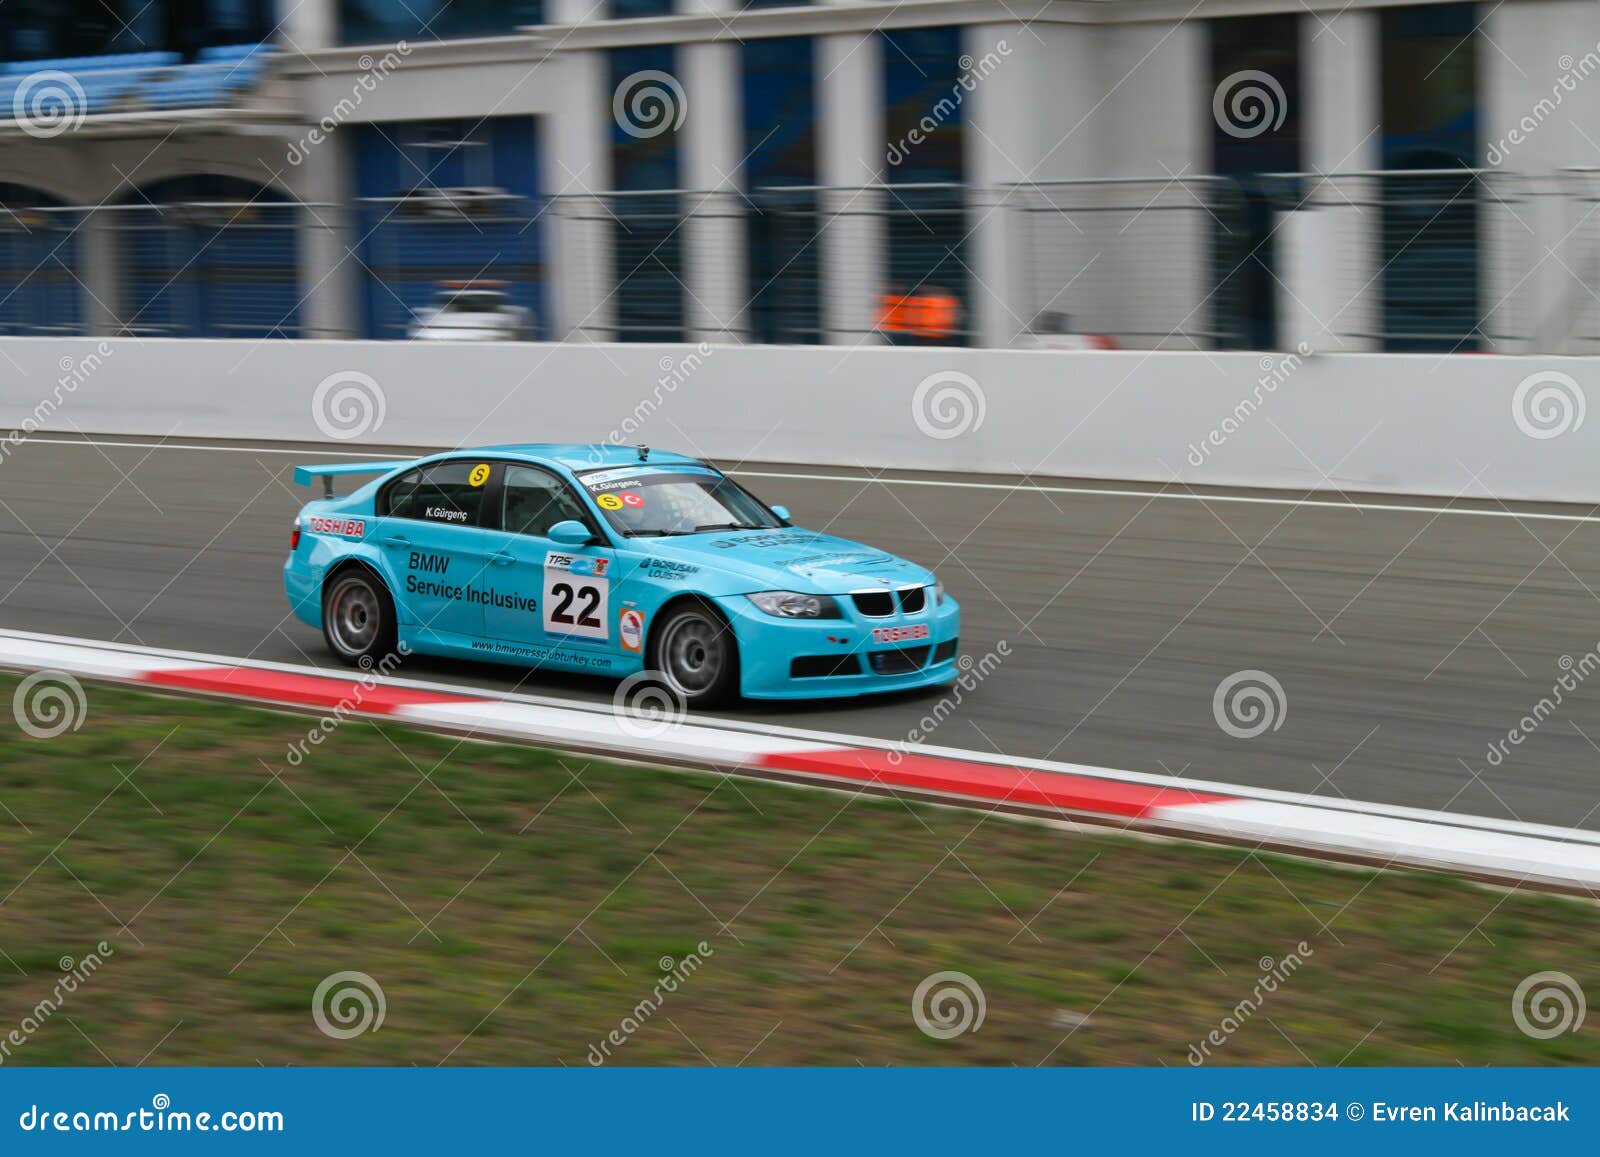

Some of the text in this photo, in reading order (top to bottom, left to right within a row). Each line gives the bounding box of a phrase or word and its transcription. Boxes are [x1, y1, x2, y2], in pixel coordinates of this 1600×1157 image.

[474, 468, 486, 481] S
[603, 496, 618, 507] S
[425, 507, 468, 522] K.Gürgenç
[308, 517, 365, 538] TOSHIBA
[408, 551, 449, 574] BMW
[548, 555, 573, 566] TPS
[406, 575, 537, 612] Service Inclusive
[550, 583, 601, 628] 22
[872, 624, 929, 644] TOSHIBA
[471, 640, 612, 668] www.bmwpressclubturkey.com
